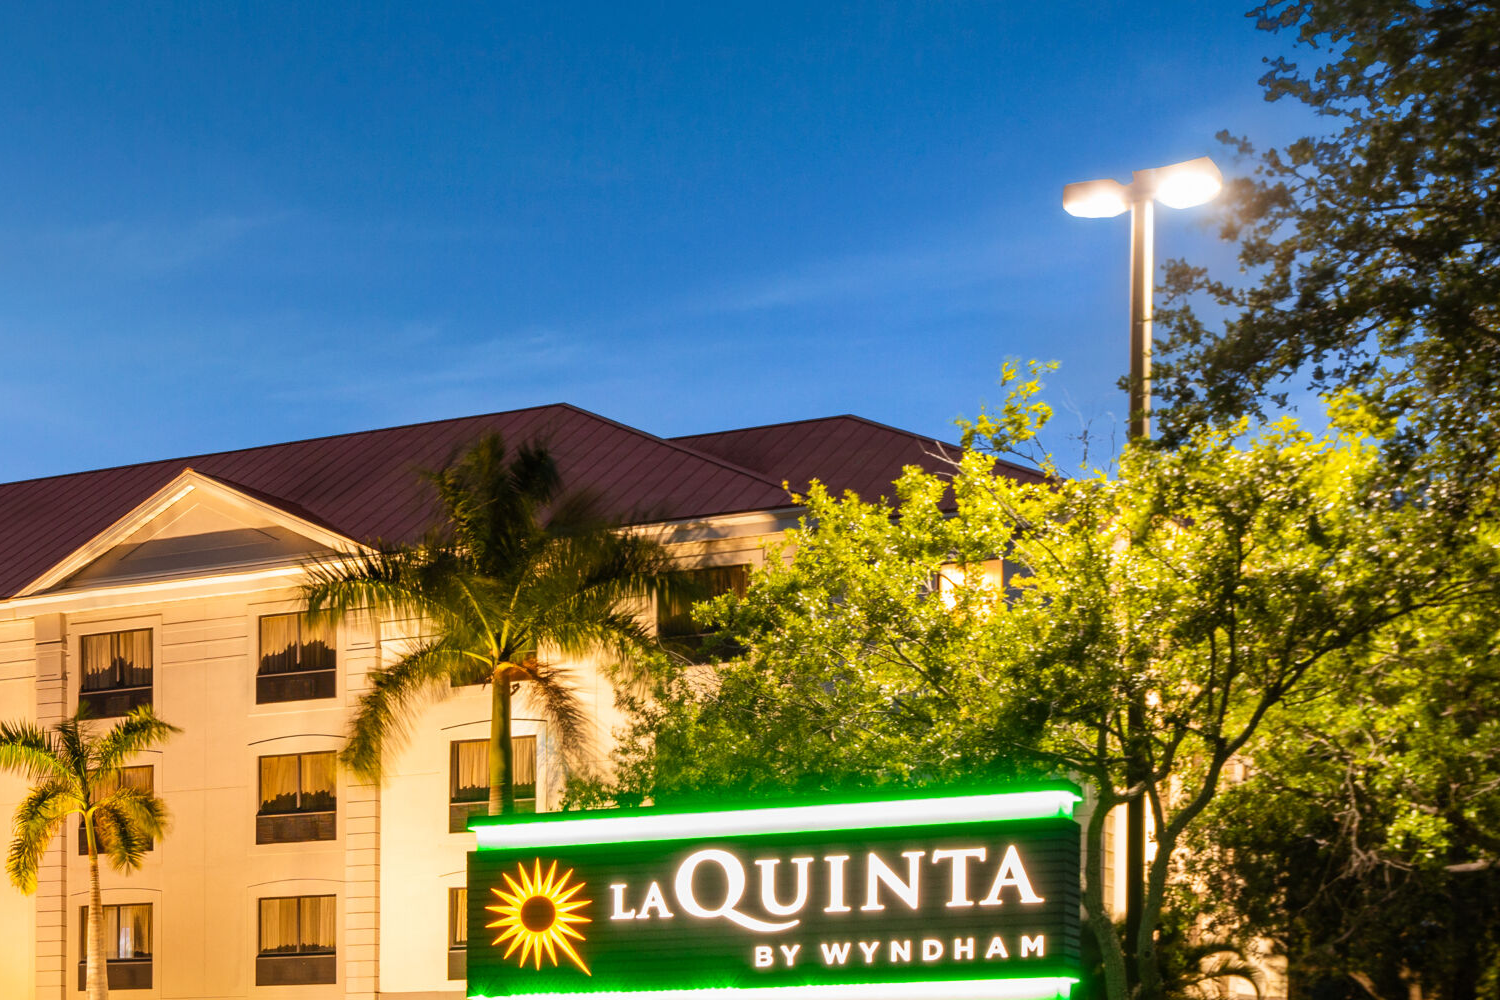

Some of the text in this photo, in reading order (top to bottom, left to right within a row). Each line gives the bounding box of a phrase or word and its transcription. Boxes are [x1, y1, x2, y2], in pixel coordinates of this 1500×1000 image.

[610, 844, 1045, 932] LA QUINTA
[755, 935, 1045, 967] BY WYNDHAM
